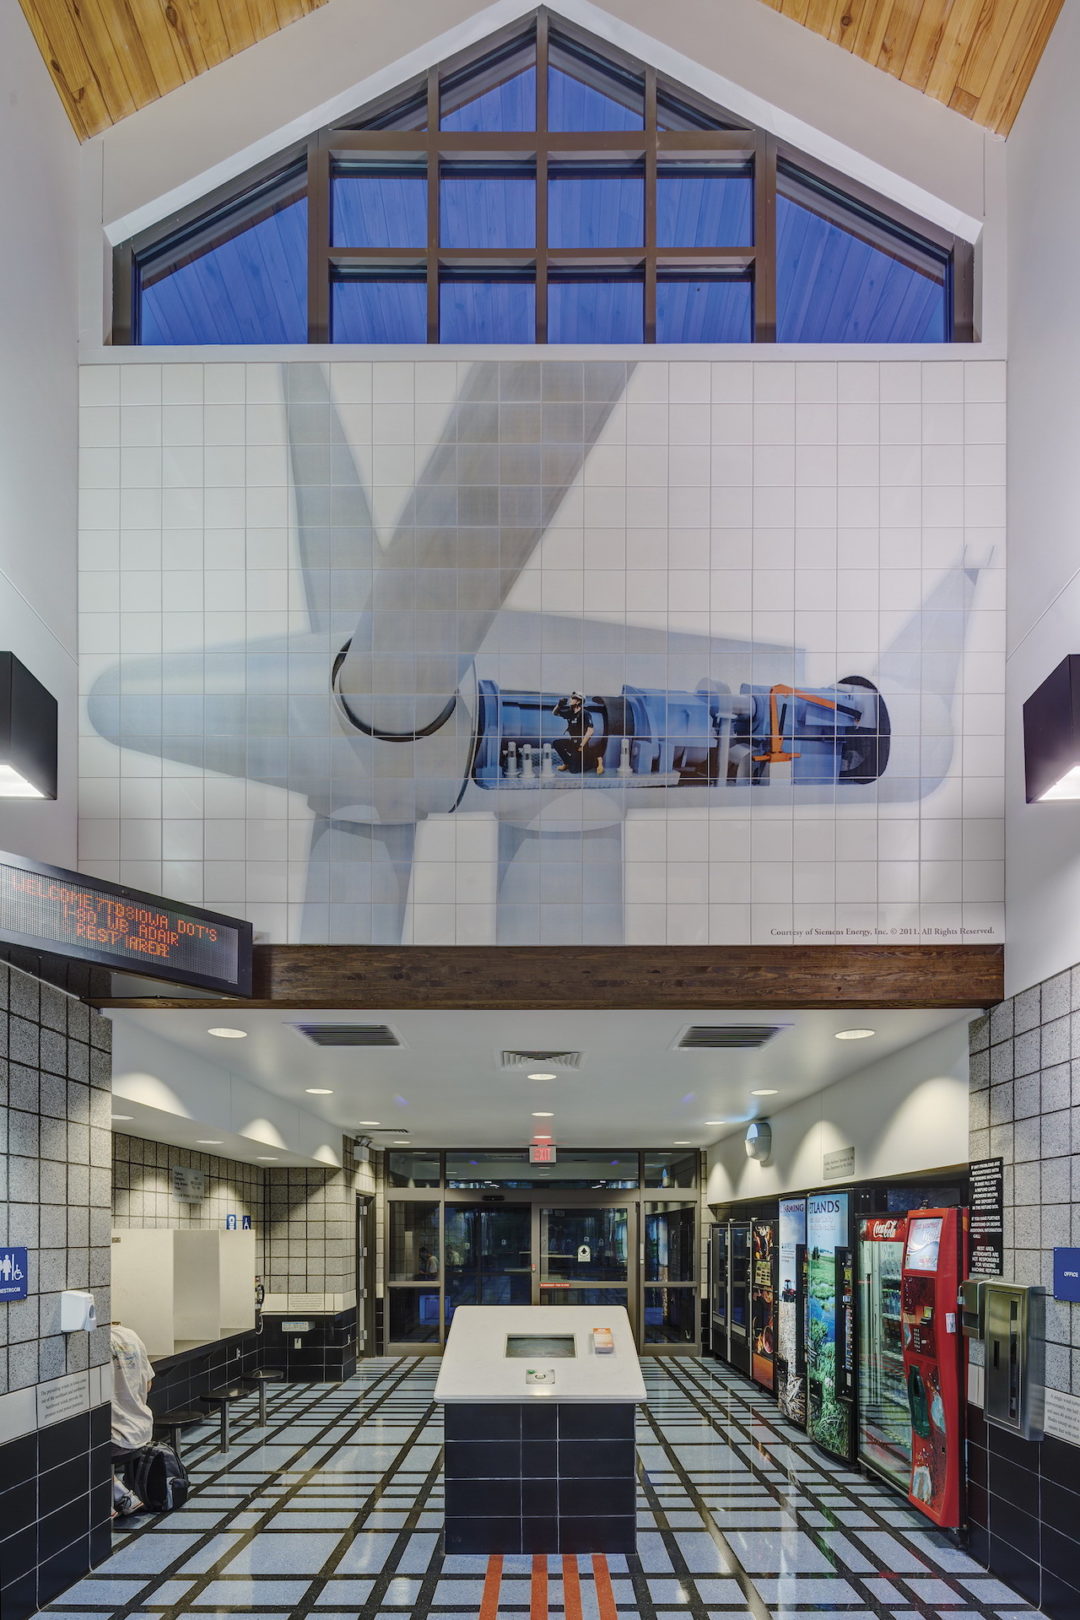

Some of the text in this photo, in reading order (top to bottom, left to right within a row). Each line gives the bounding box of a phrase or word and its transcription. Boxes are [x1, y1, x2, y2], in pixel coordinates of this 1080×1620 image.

[12, 875, 95, 911] WELCOME
[136, 908, 169, 930] IOWA
[178, 919, 218, 942] DOT'S
[77, 922, 119, 946] REST
[139, 924, 180, 947] ADAIR
[770, 928, 804, 938] Courtesy
[805, 928, 813, 936] of
[814, 928, 844, 936] Siemens
[874, 928, 889, 936] Inc.
[934, 928, 958, 937] Rights
[960, 927, 995, 935] Reserved.
[534, 1148, 551, 1161] EXIT
